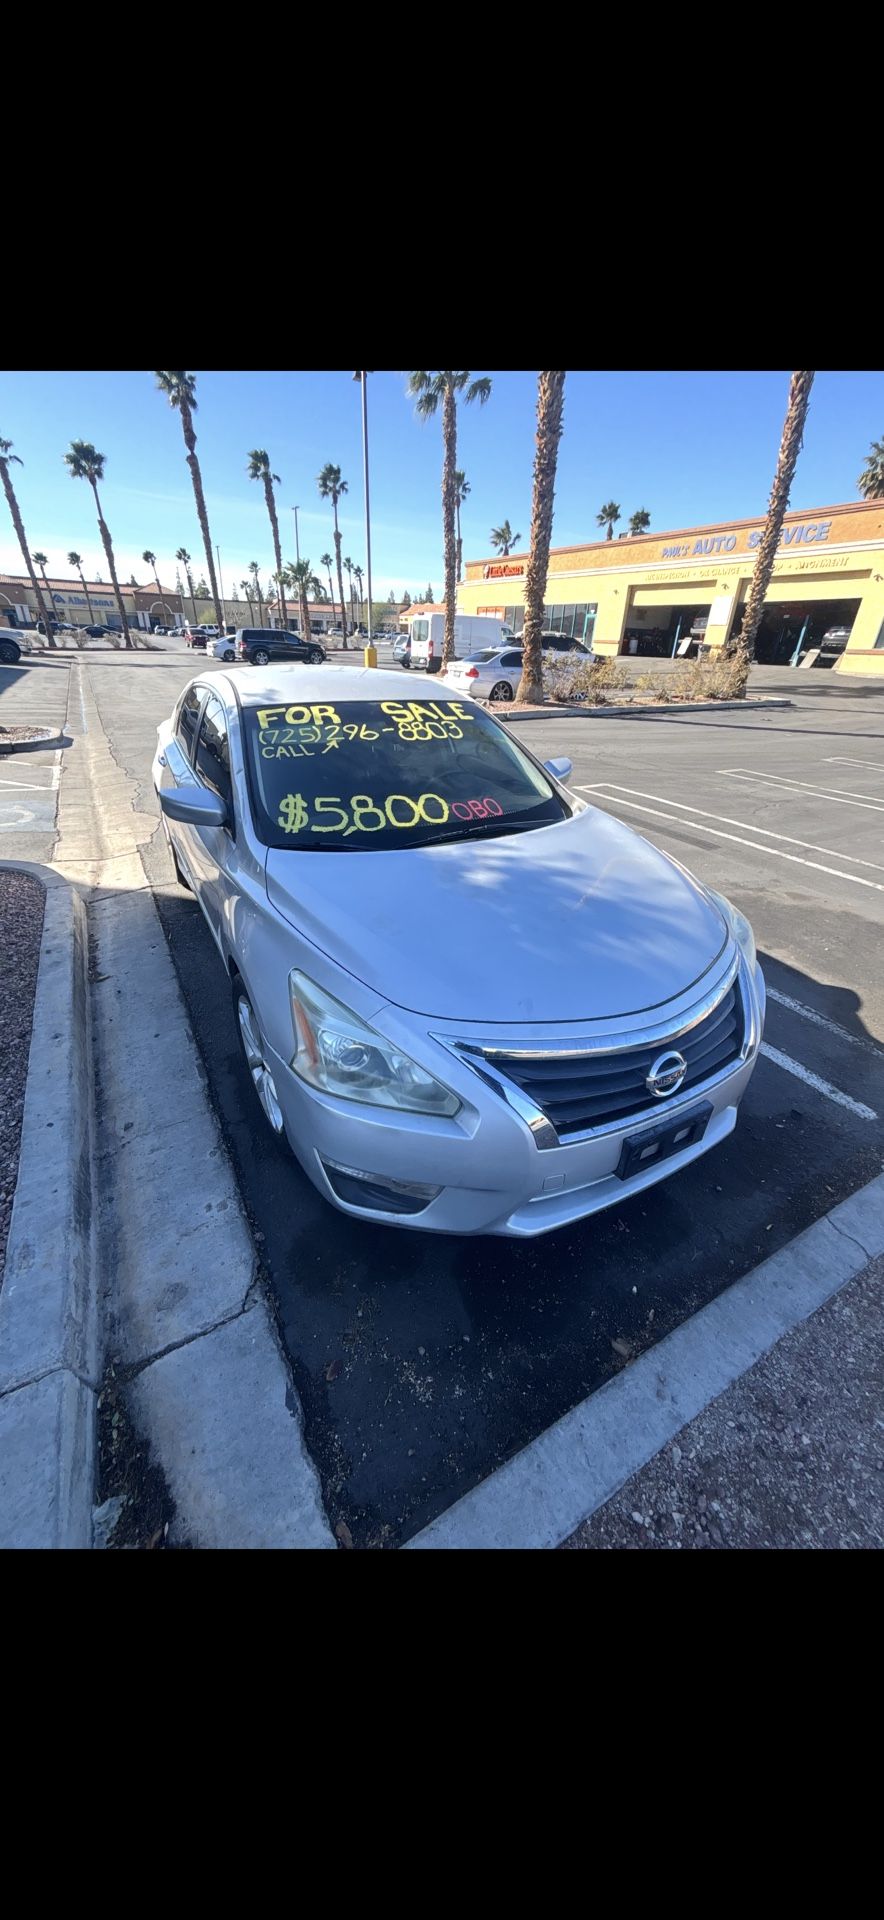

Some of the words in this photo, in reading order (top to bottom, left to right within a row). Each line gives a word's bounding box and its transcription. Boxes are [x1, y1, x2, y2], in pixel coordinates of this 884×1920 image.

[692, 535, 737, 555] AUTO
[747, 521, 832, 549] SVICE
[256, 705, 342, 729] FOR
[380, 701, 475, 723] SALE
[261, 744, 315, 760] CALL
[277, 793, 450, 837] $5,800
[451, 797, 503, 820] OBO
[653, 1068, 686, 1087] NISSAN
